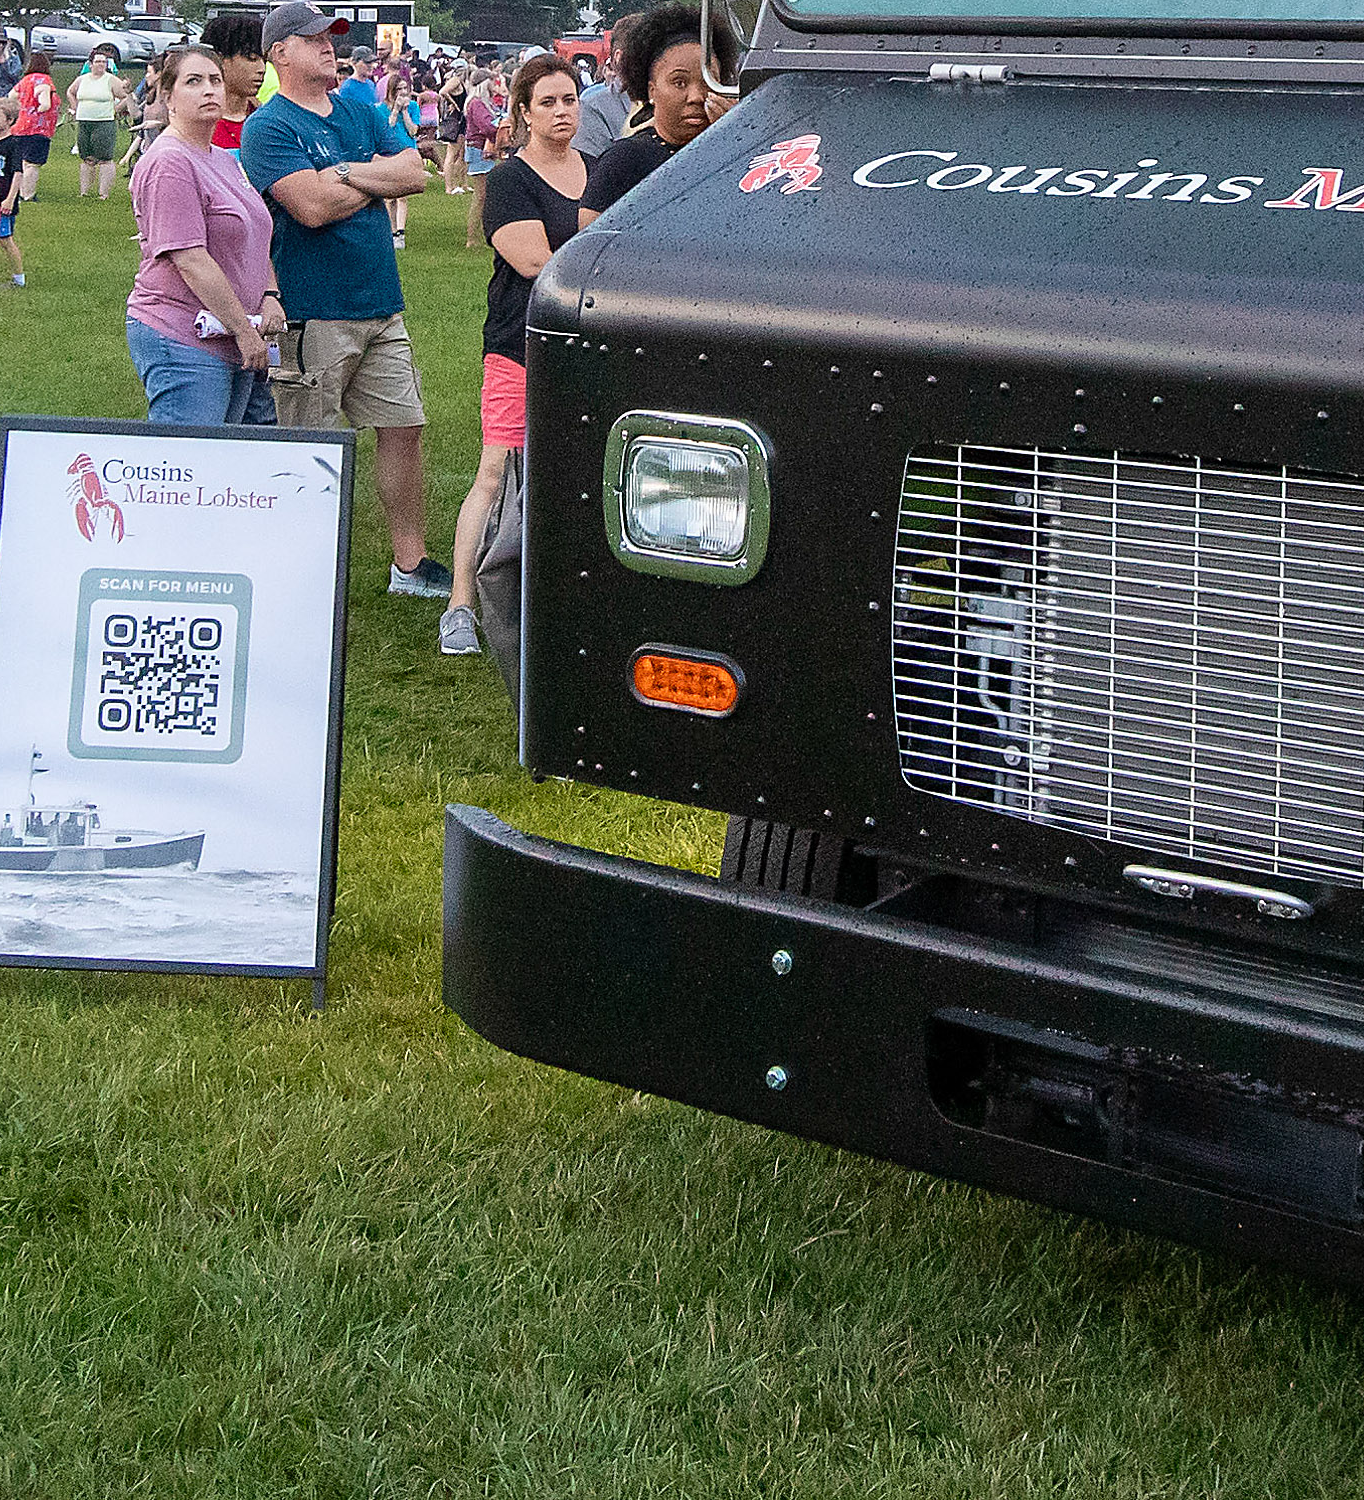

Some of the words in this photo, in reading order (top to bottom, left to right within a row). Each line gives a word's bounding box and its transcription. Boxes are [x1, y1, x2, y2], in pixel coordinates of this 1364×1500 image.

[852, 150, 1265, 204] Cousins
[102, 459, 194, 484] Cousins
[123, 483, 191, 506] Maine
[196, 486, 278, 510] Lobster
[99, 577, 144, 592] SCAN
[148, 579, 181, 593] FOR
[185, 581, 234, 595] MENU
